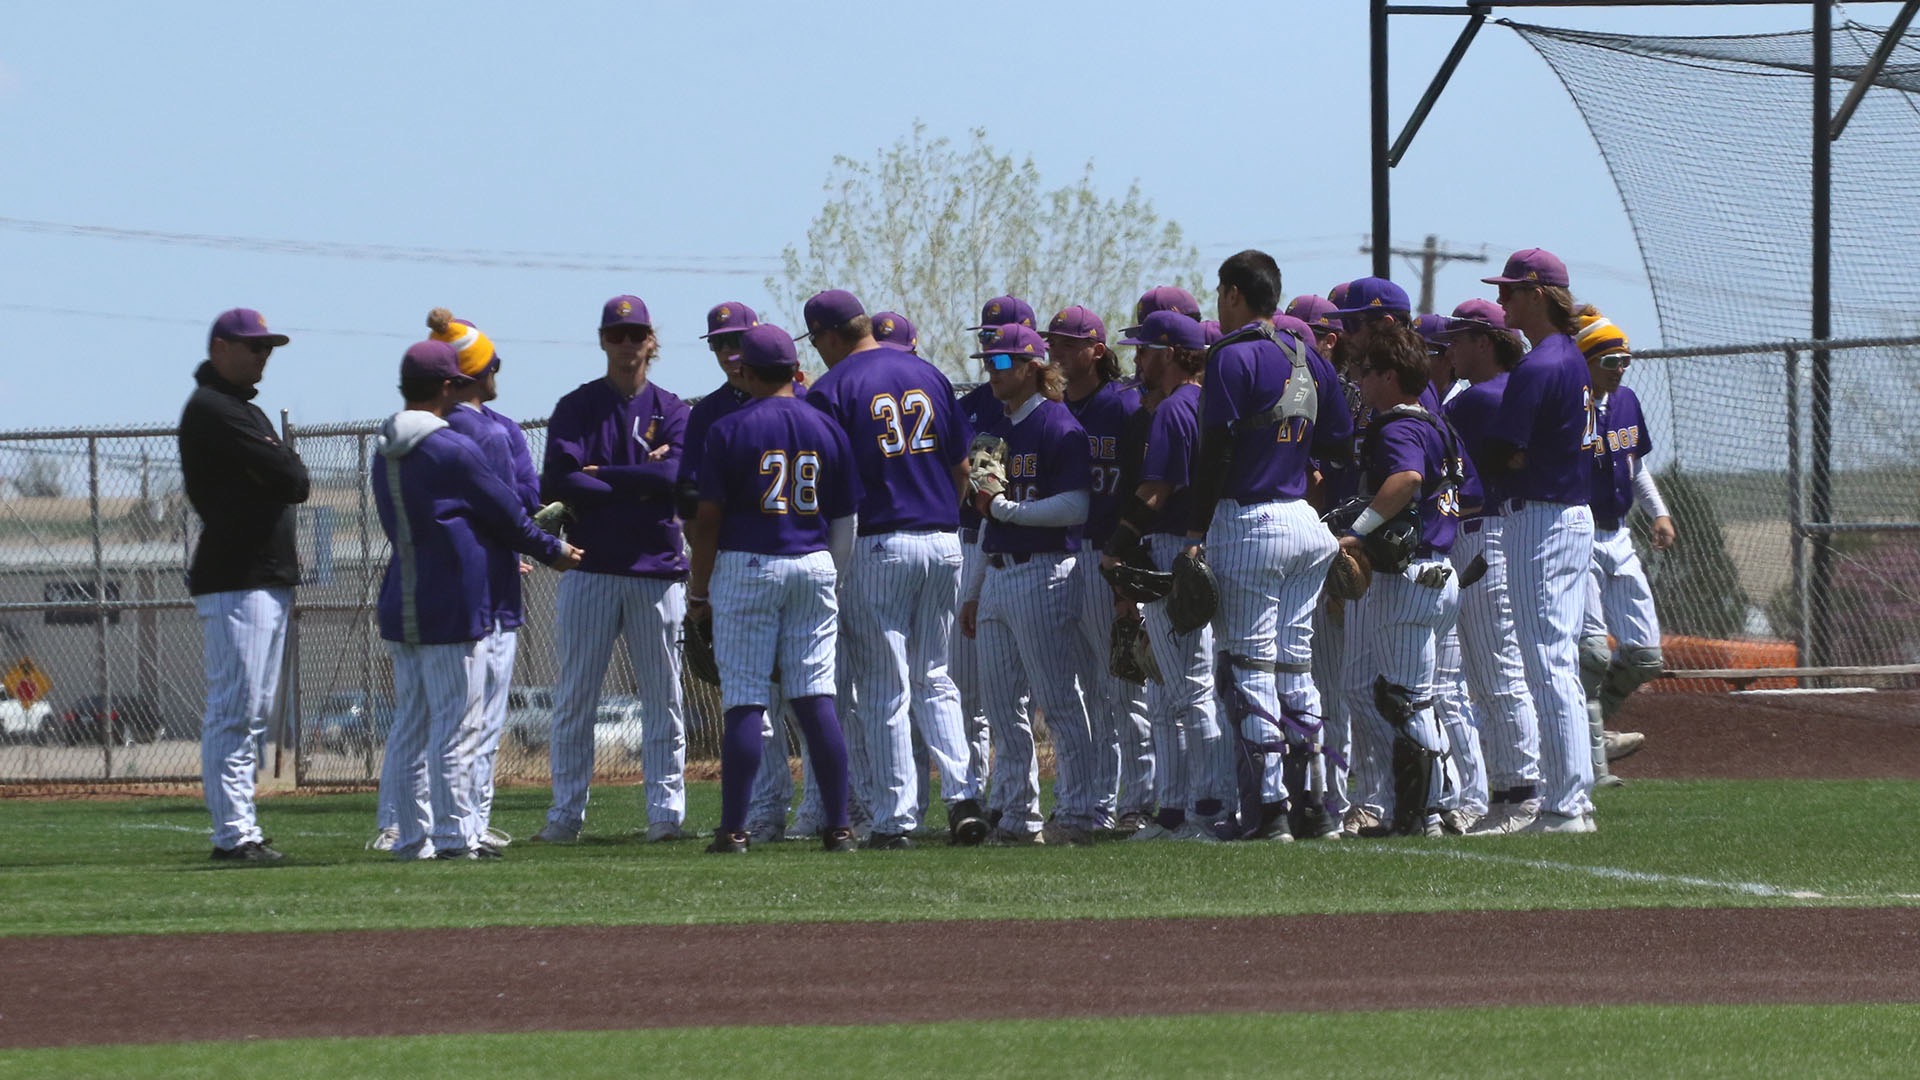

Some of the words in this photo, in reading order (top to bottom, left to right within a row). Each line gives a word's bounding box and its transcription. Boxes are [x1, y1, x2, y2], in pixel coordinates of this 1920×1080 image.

[870, 388, 937, 458] 32
[759, 449, 822, 515] 28
[1090, 464, 1122, 496] 37
